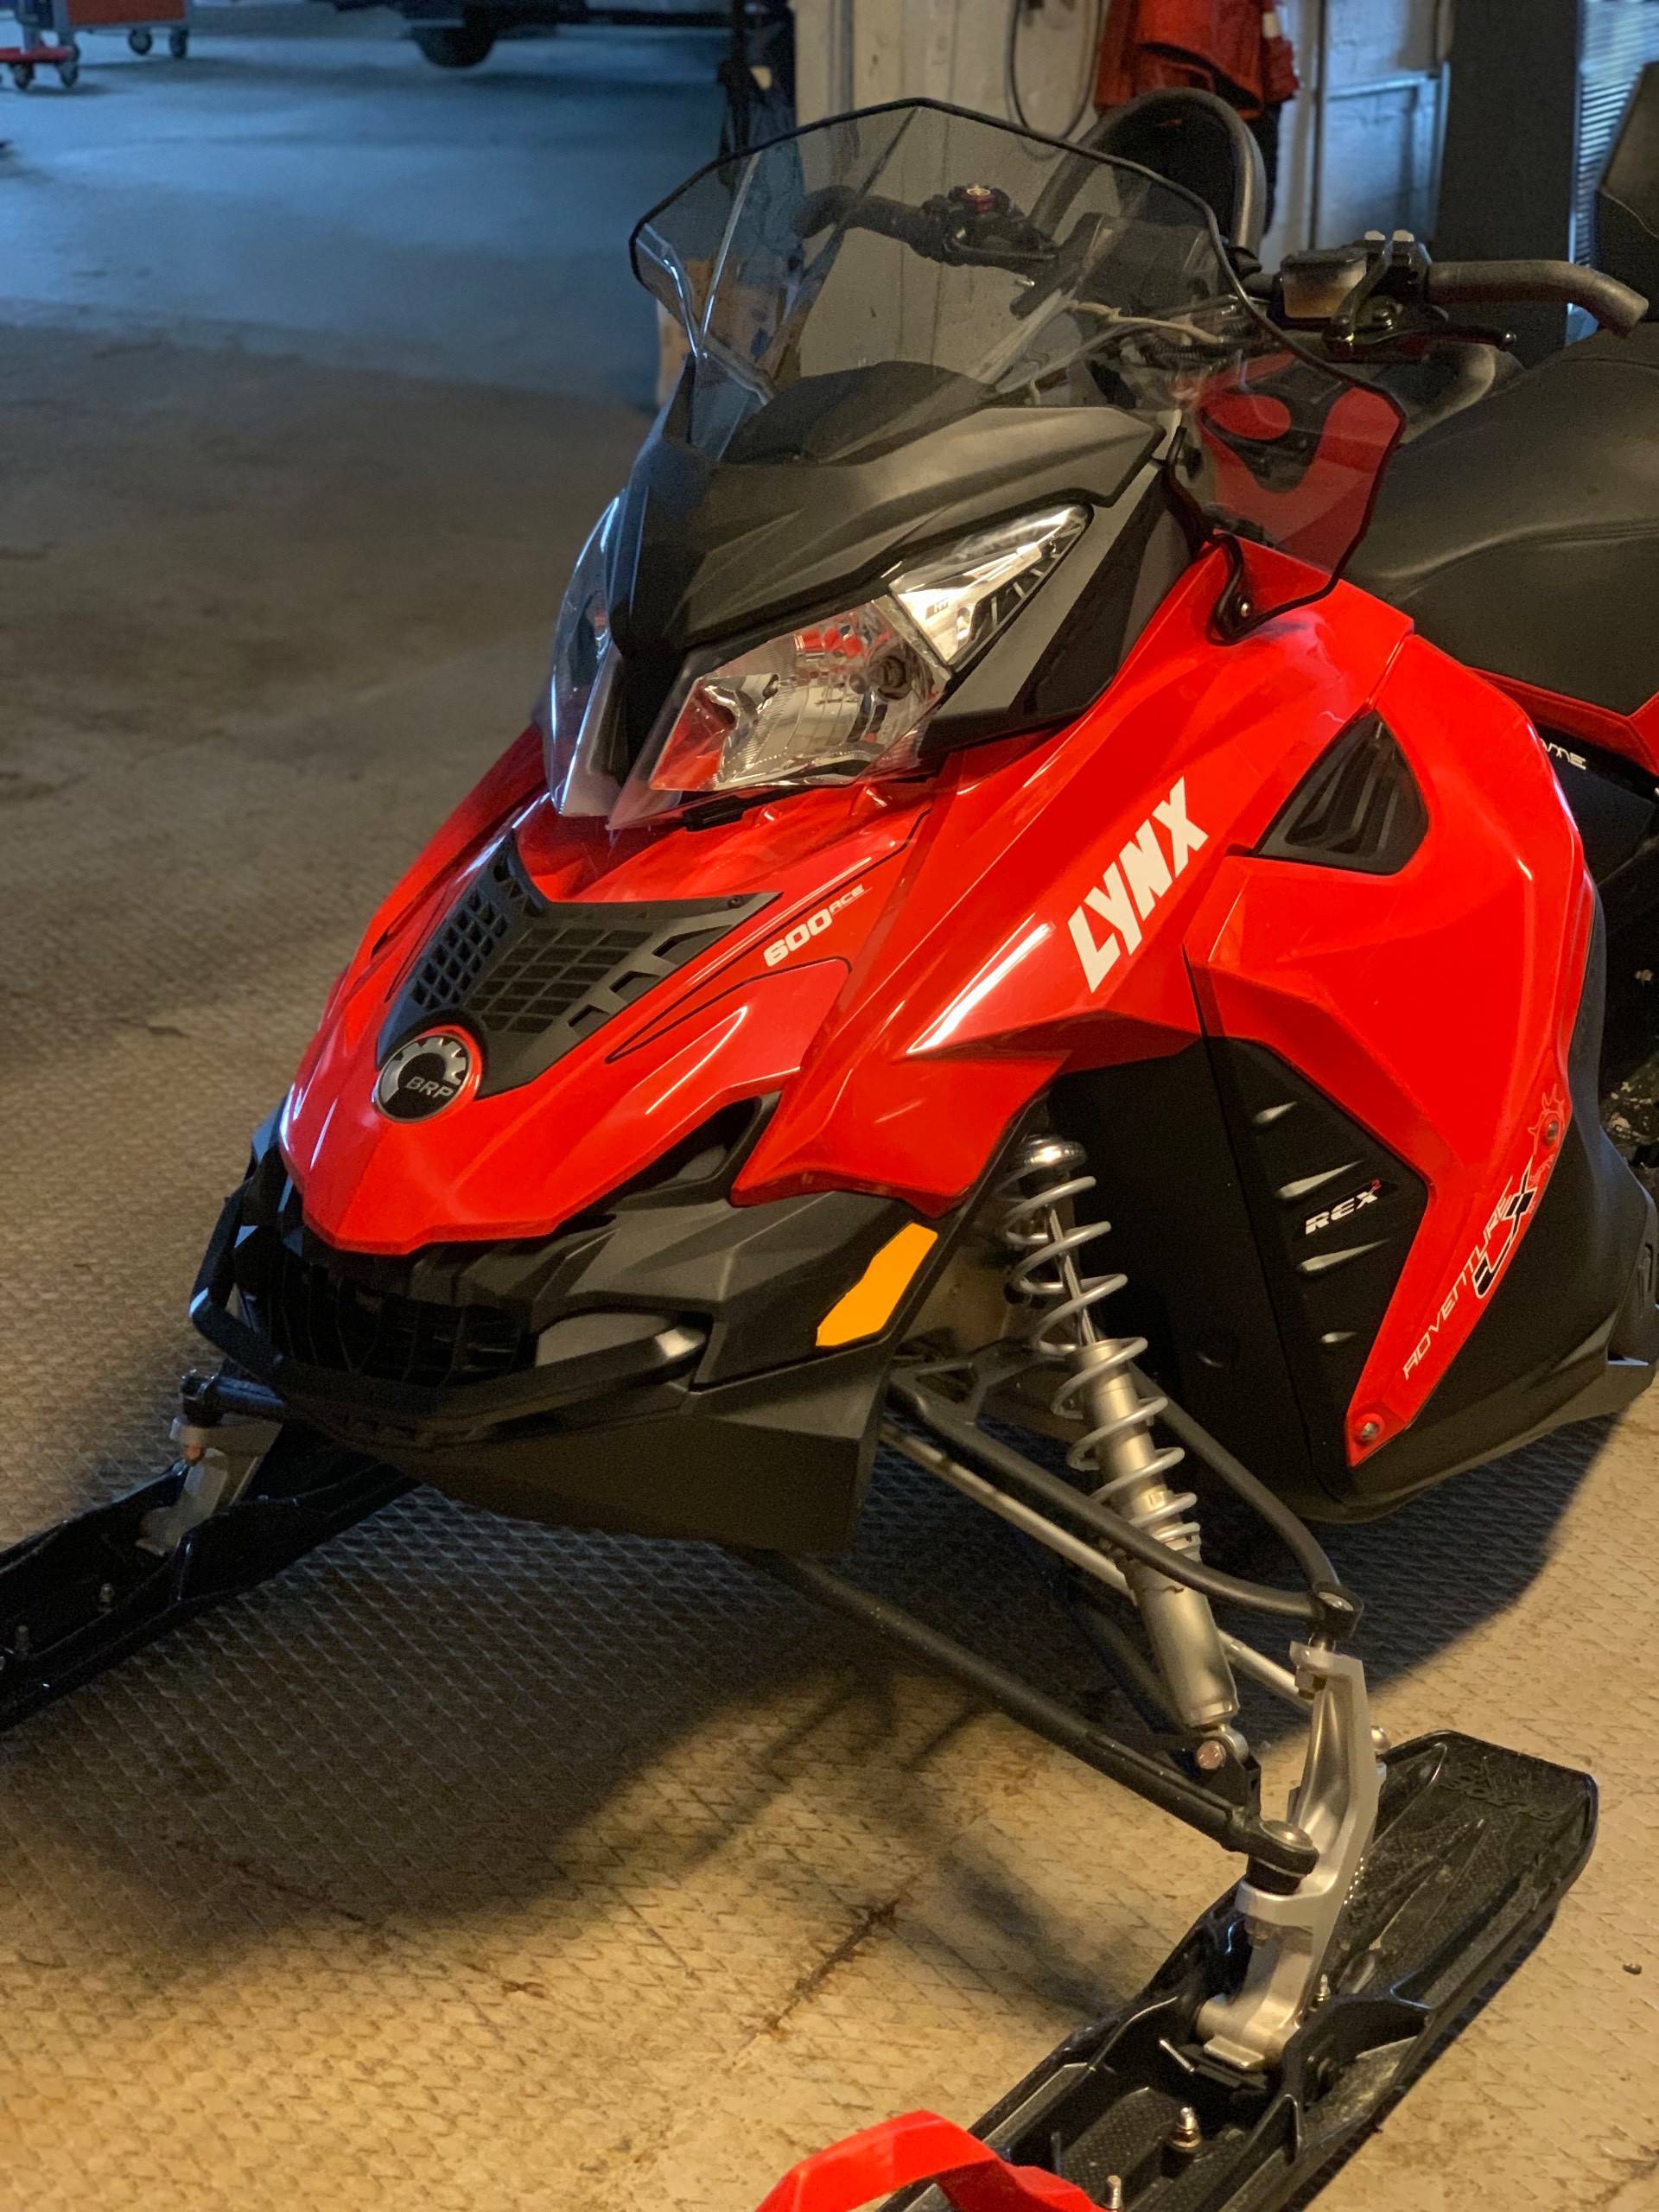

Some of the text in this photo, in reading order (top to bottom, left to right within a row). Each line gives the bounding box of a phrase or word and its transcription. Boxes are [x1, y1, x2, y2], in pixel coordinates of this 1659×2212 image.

[1067, 775, 1209, 994] LYNX
[405, 1076, 454, 1098] BRP
[1402, 1174, 1514, 1381] ADVENTURE
